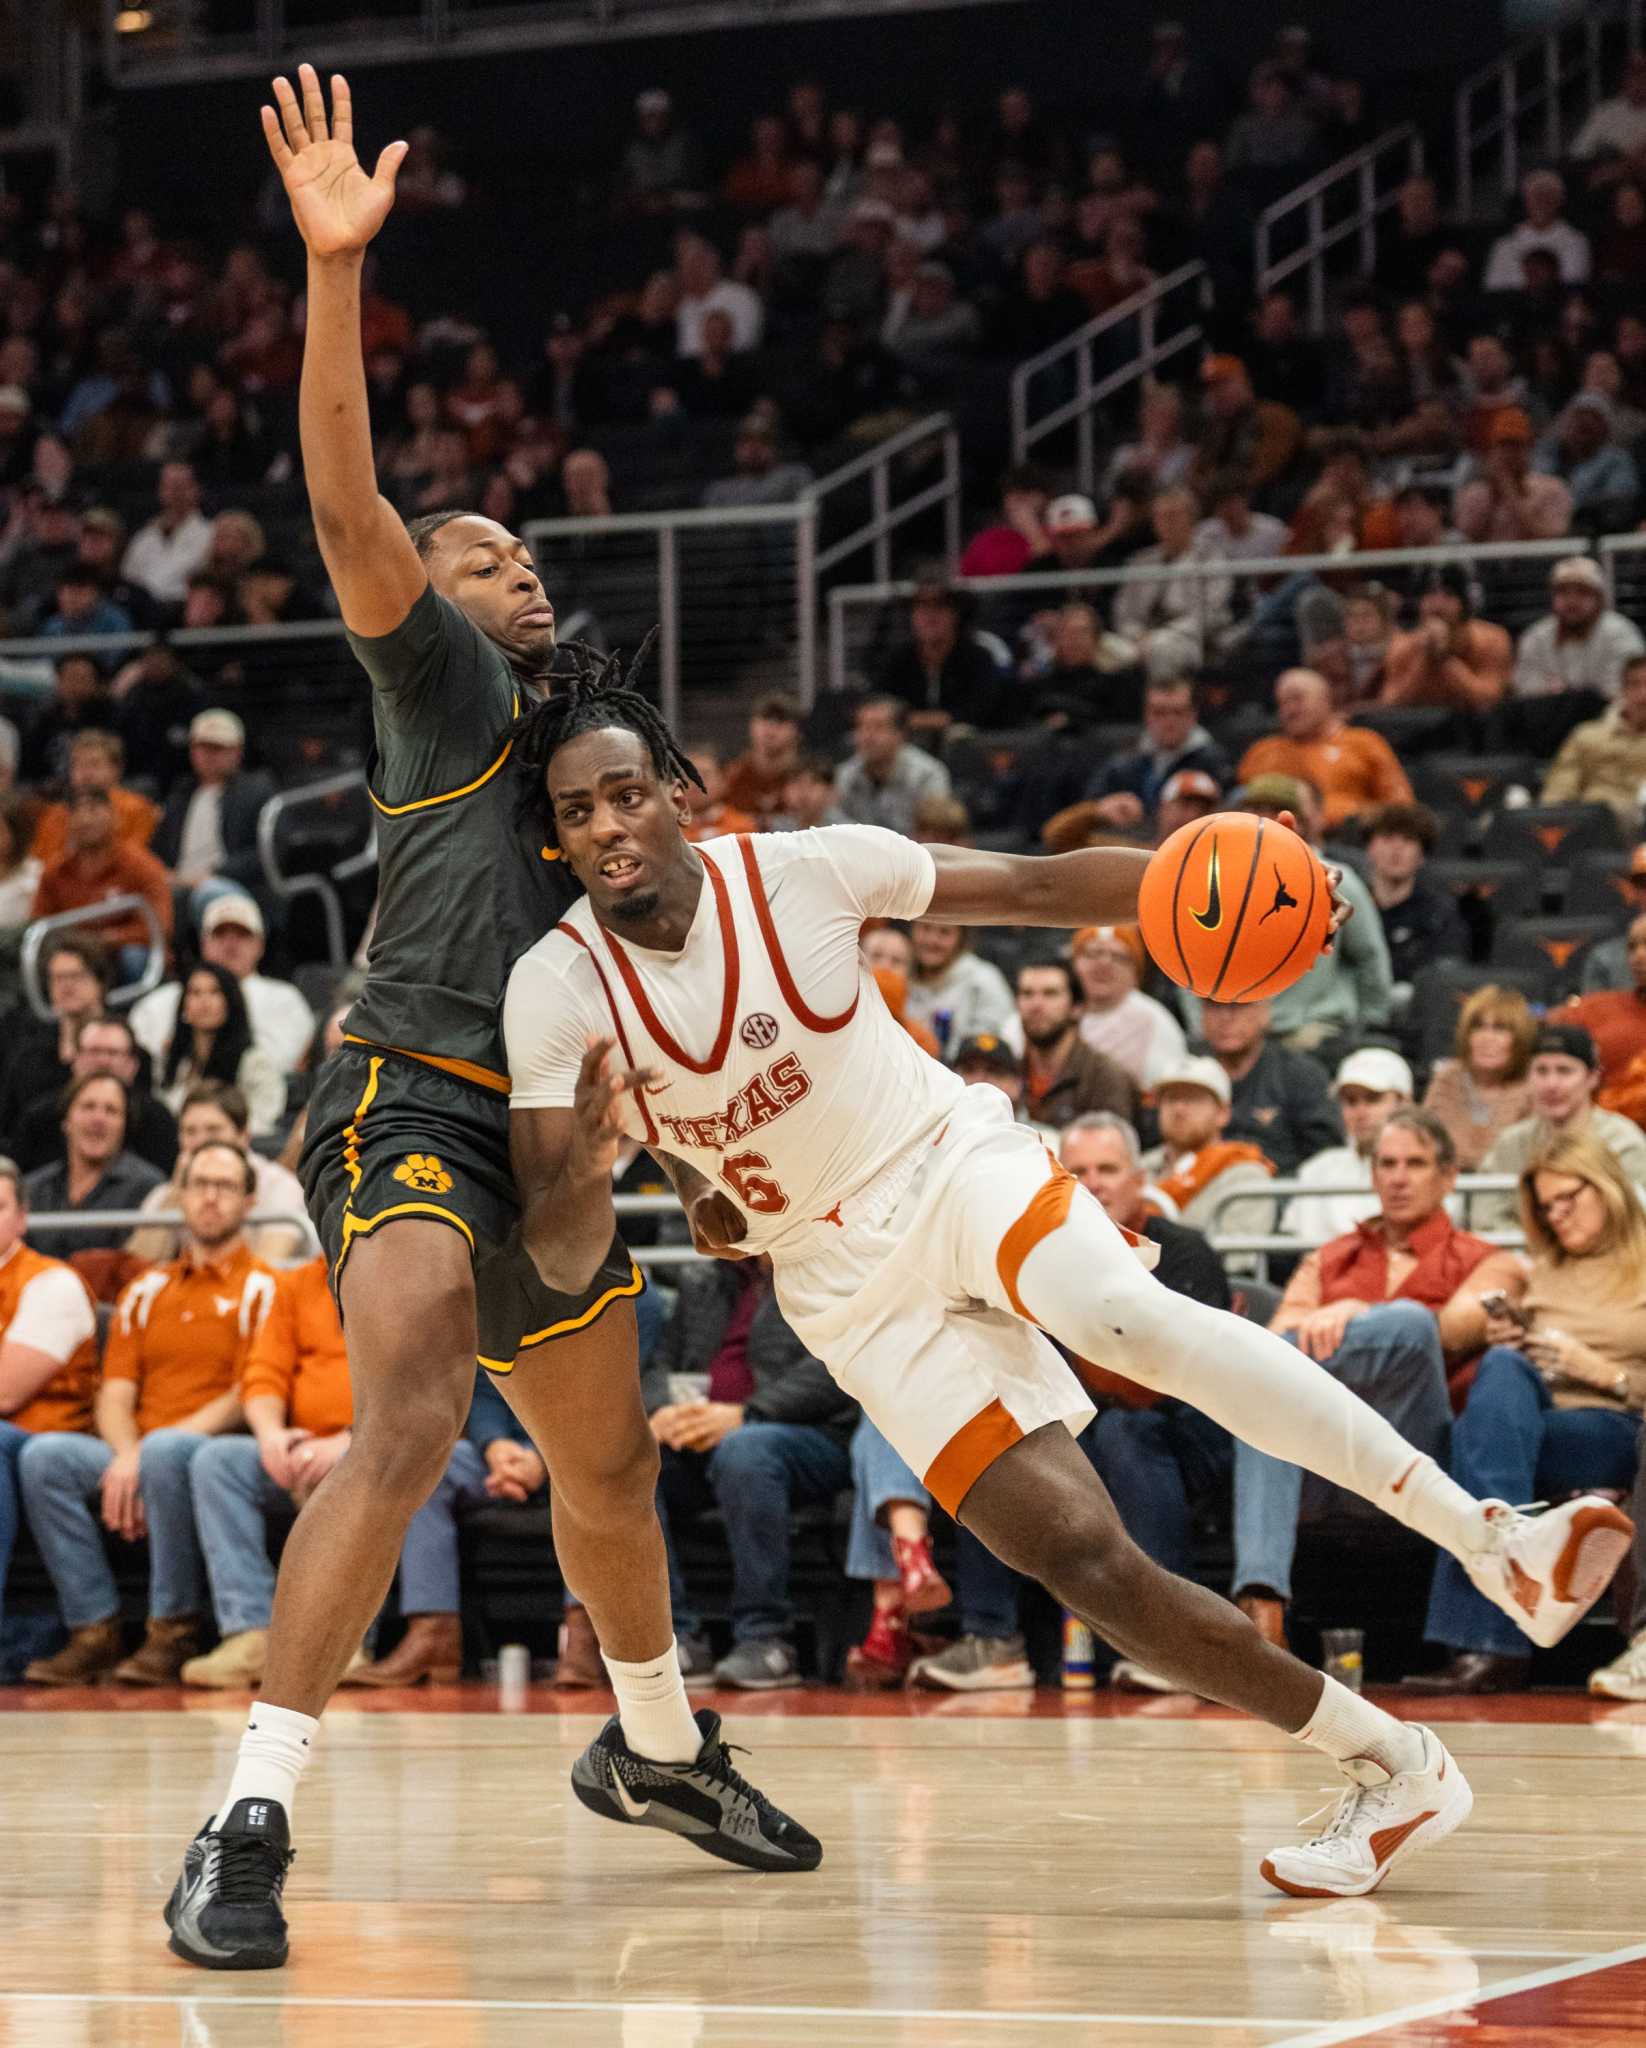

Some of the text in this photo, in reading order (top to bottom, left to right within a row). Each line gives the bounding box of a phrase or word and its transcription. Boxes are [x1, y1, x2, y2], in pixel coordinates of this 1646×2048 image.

[741, 1013, 778, 1049] SEC
[656, 1051, 813, 1152] TEXAS
[414, 1176, 439, 1190] M
[718, 1150, 791, 1215] 6
